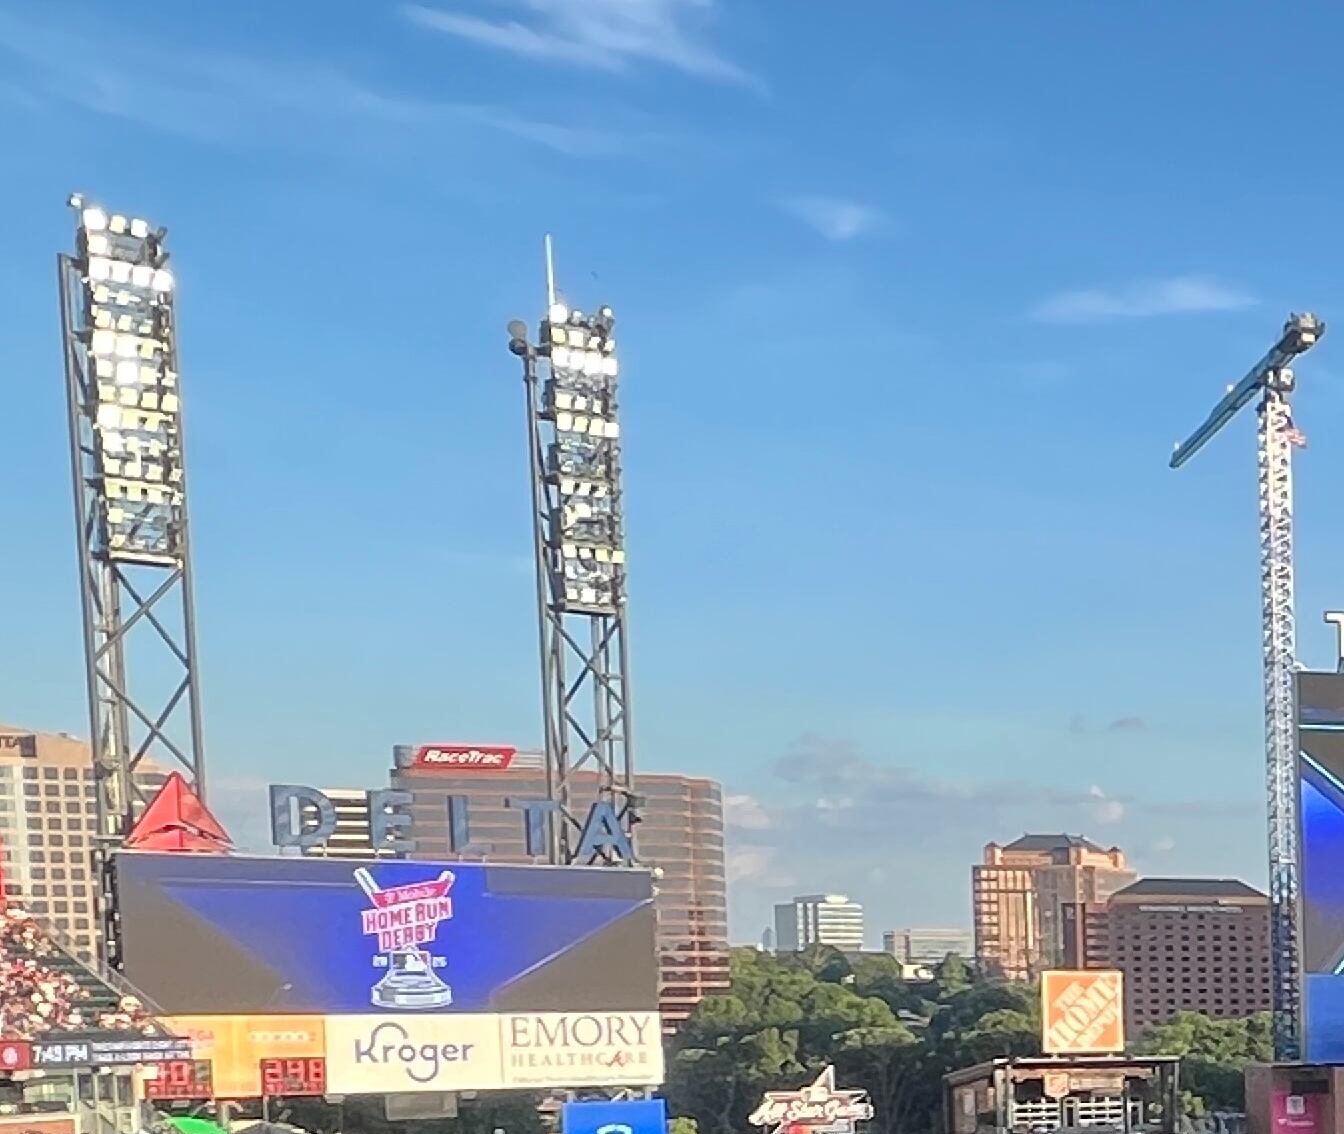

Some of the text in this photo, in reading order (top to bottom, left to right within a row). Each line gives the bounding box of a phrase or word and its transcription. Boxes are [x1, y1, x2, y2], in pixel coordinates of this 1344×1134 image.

[424, 749, 504, 764] RaceTrac
[269, 784, 640, 867] DELTA
[366, 900, 450, 932] HOME RUN
[382, 923, 434, 950] DERBY
[1048, 976, 1117, 1047] HOME
[510, 1015, 650, 1047] EMORY
[355, 1022, 475, 1083] Kroger
[511, 1051, 648, 1067] HEALTHCARE
